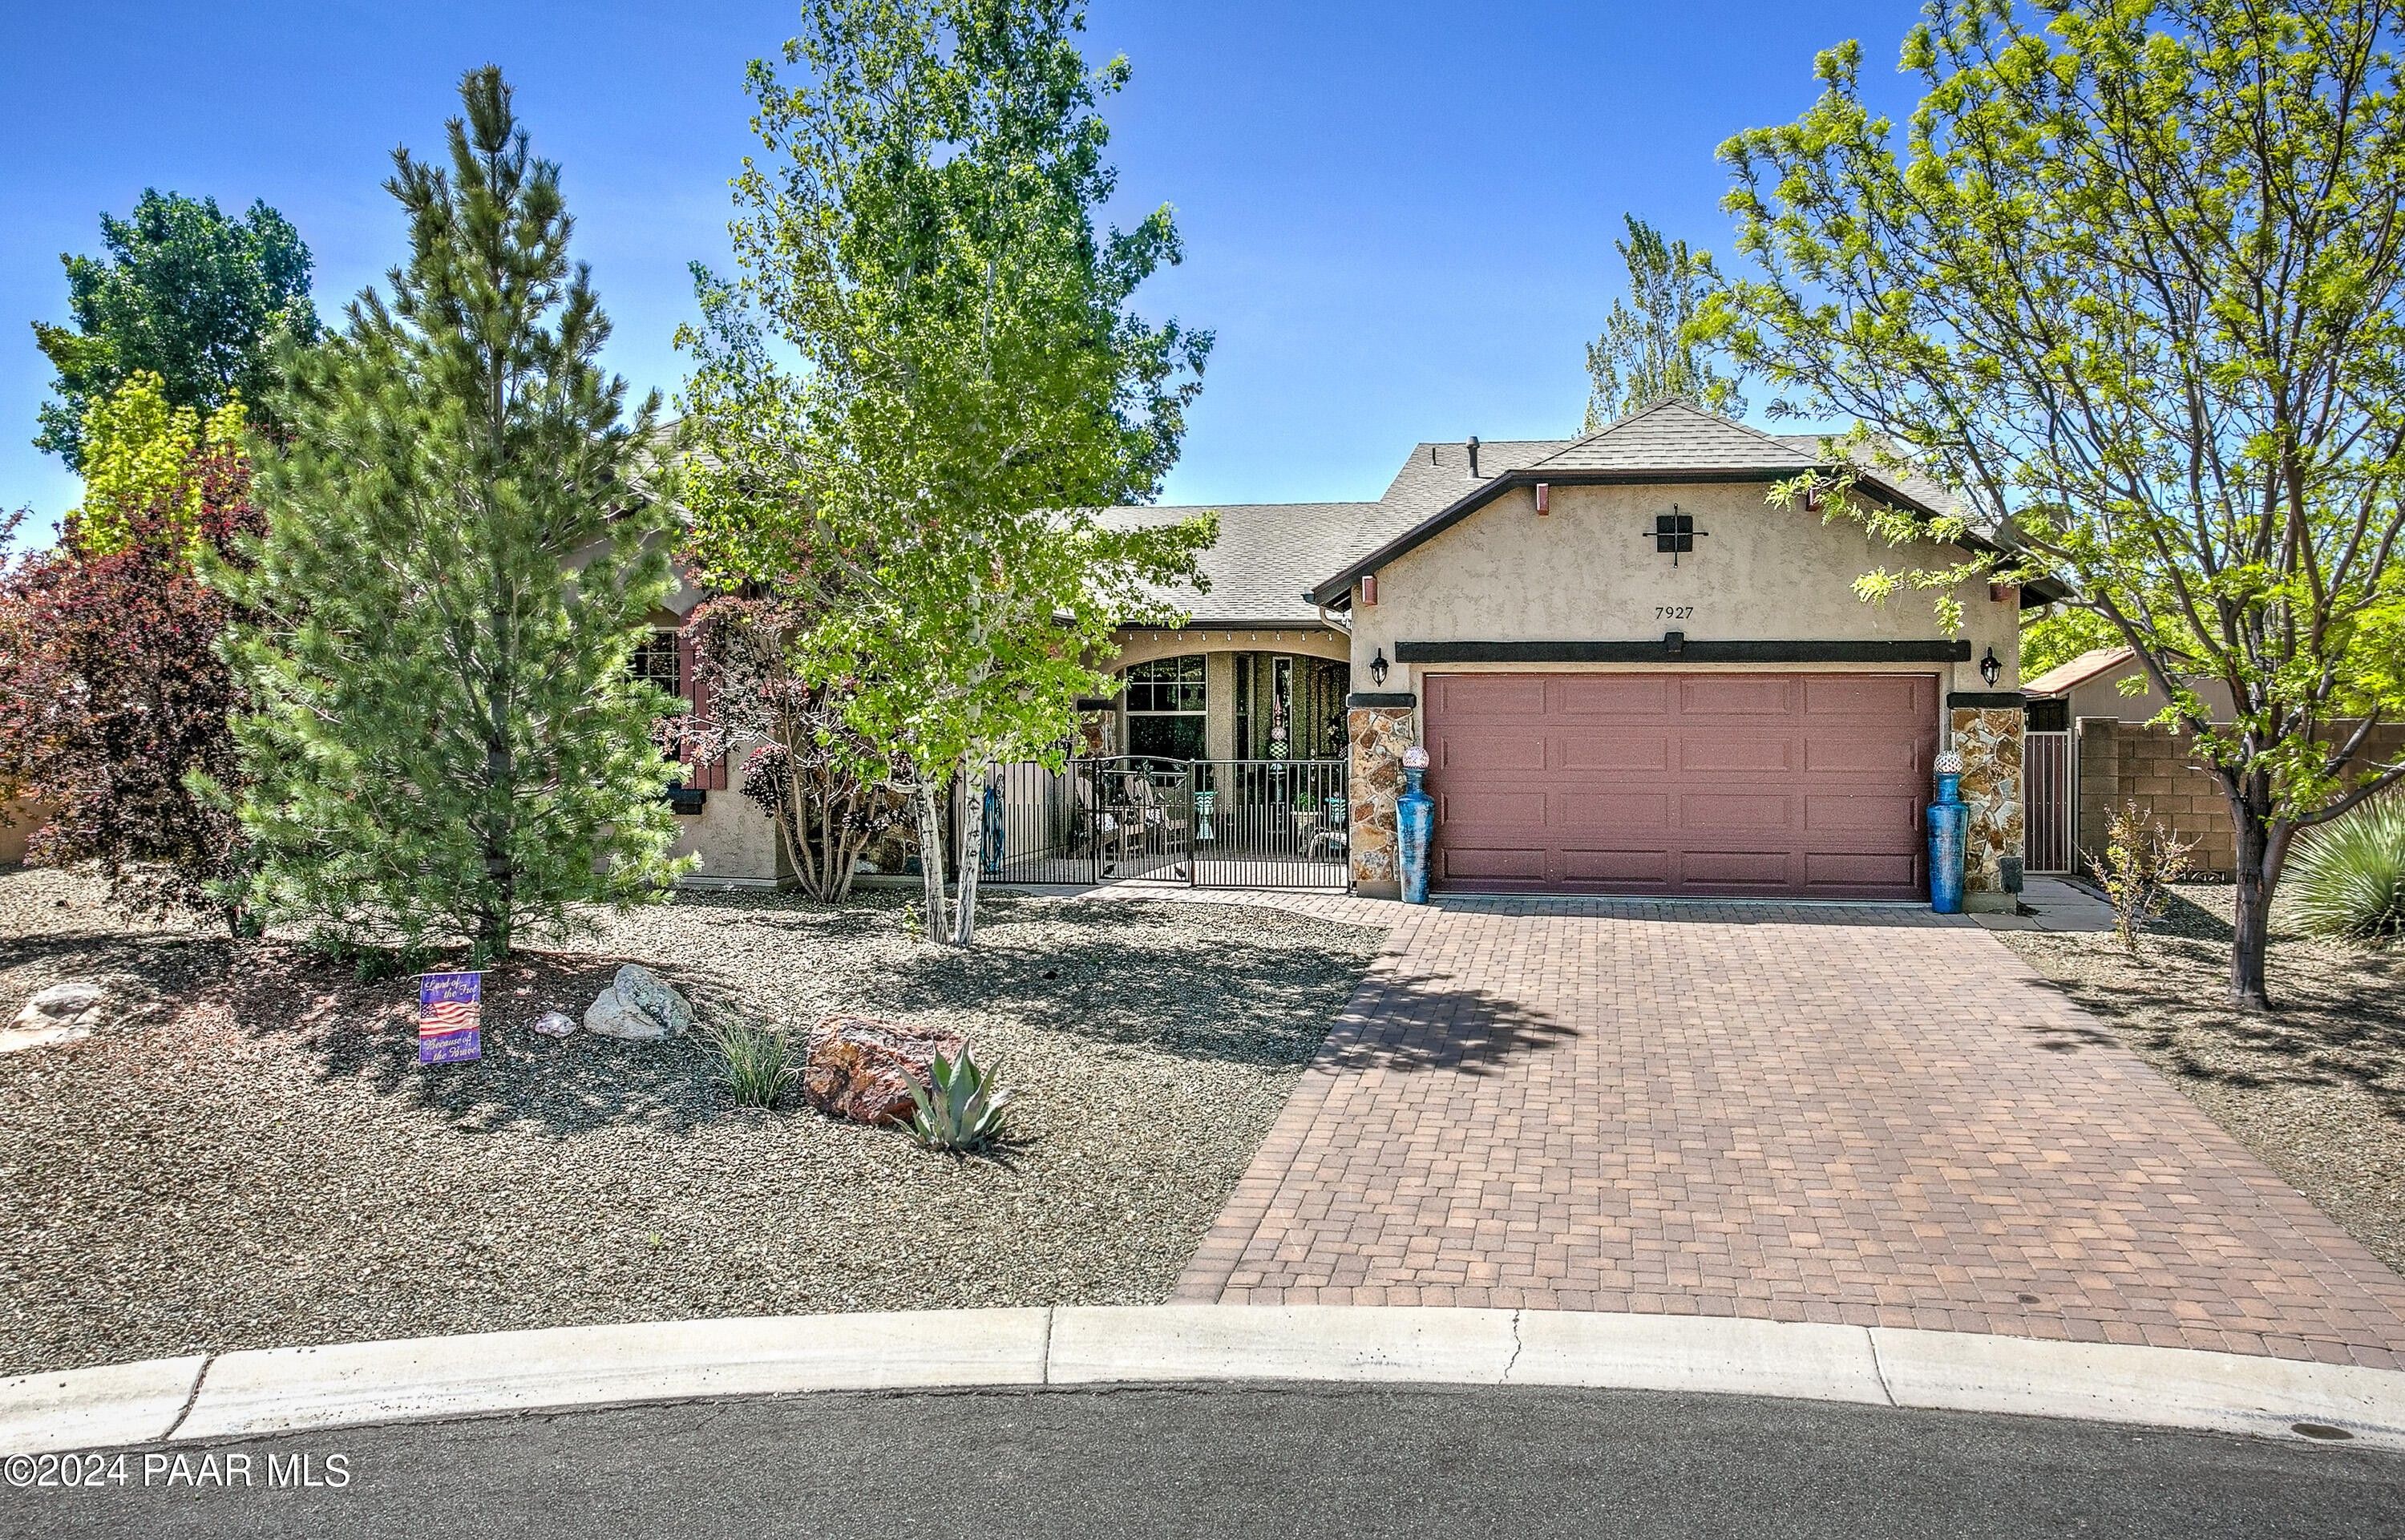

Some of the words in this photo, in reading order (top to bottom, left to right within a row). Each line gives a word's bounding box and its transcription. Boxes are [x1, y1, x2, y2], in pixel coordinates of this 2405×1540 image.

[1655, 606, 1694, 620] 7927
[425, 977, 451, 991] Land
[451, 975, 460, 989] of
[443, 987, 457, 999] the
[459, 984, 478, 996] Free
[423, 1037, 462, 1050] Because
[462, 1032, 472, 1046] of
[433, 1049, 447, 1061] the
[449, 1045, 476, 1057] Brave
